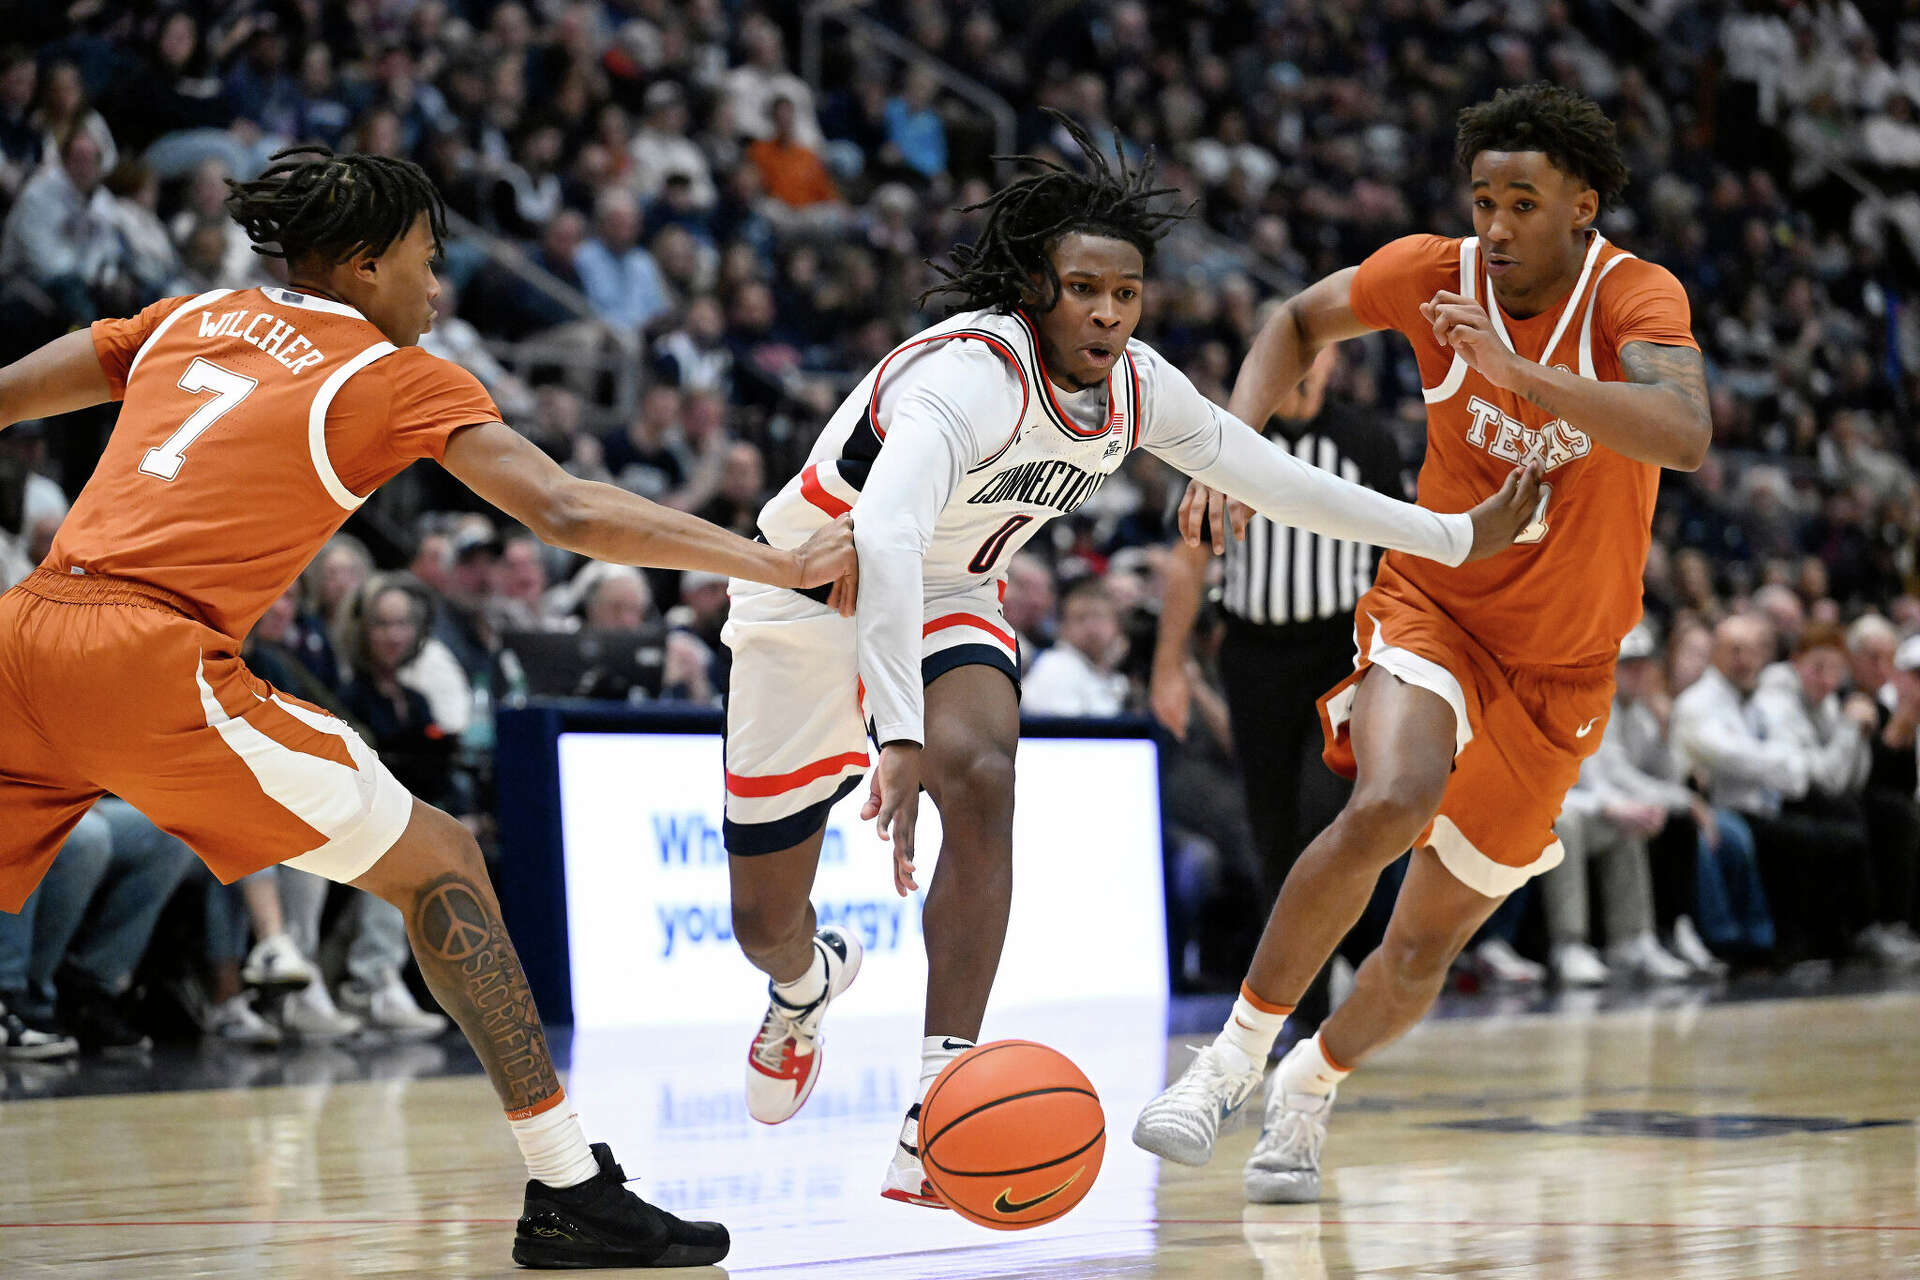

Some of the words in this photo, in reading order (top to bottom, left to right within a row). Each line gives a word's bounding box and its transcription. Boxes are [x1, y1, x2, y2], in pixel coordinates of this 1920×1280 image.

[197, 309, 325, 375] WILCHER
[137, 356, 259, 482] 7
[1466, 395, 1592, 473] TEXAS
[967, 514, 1034, 574] 0
[461, 950, 543, 1098] SACRIFICE
